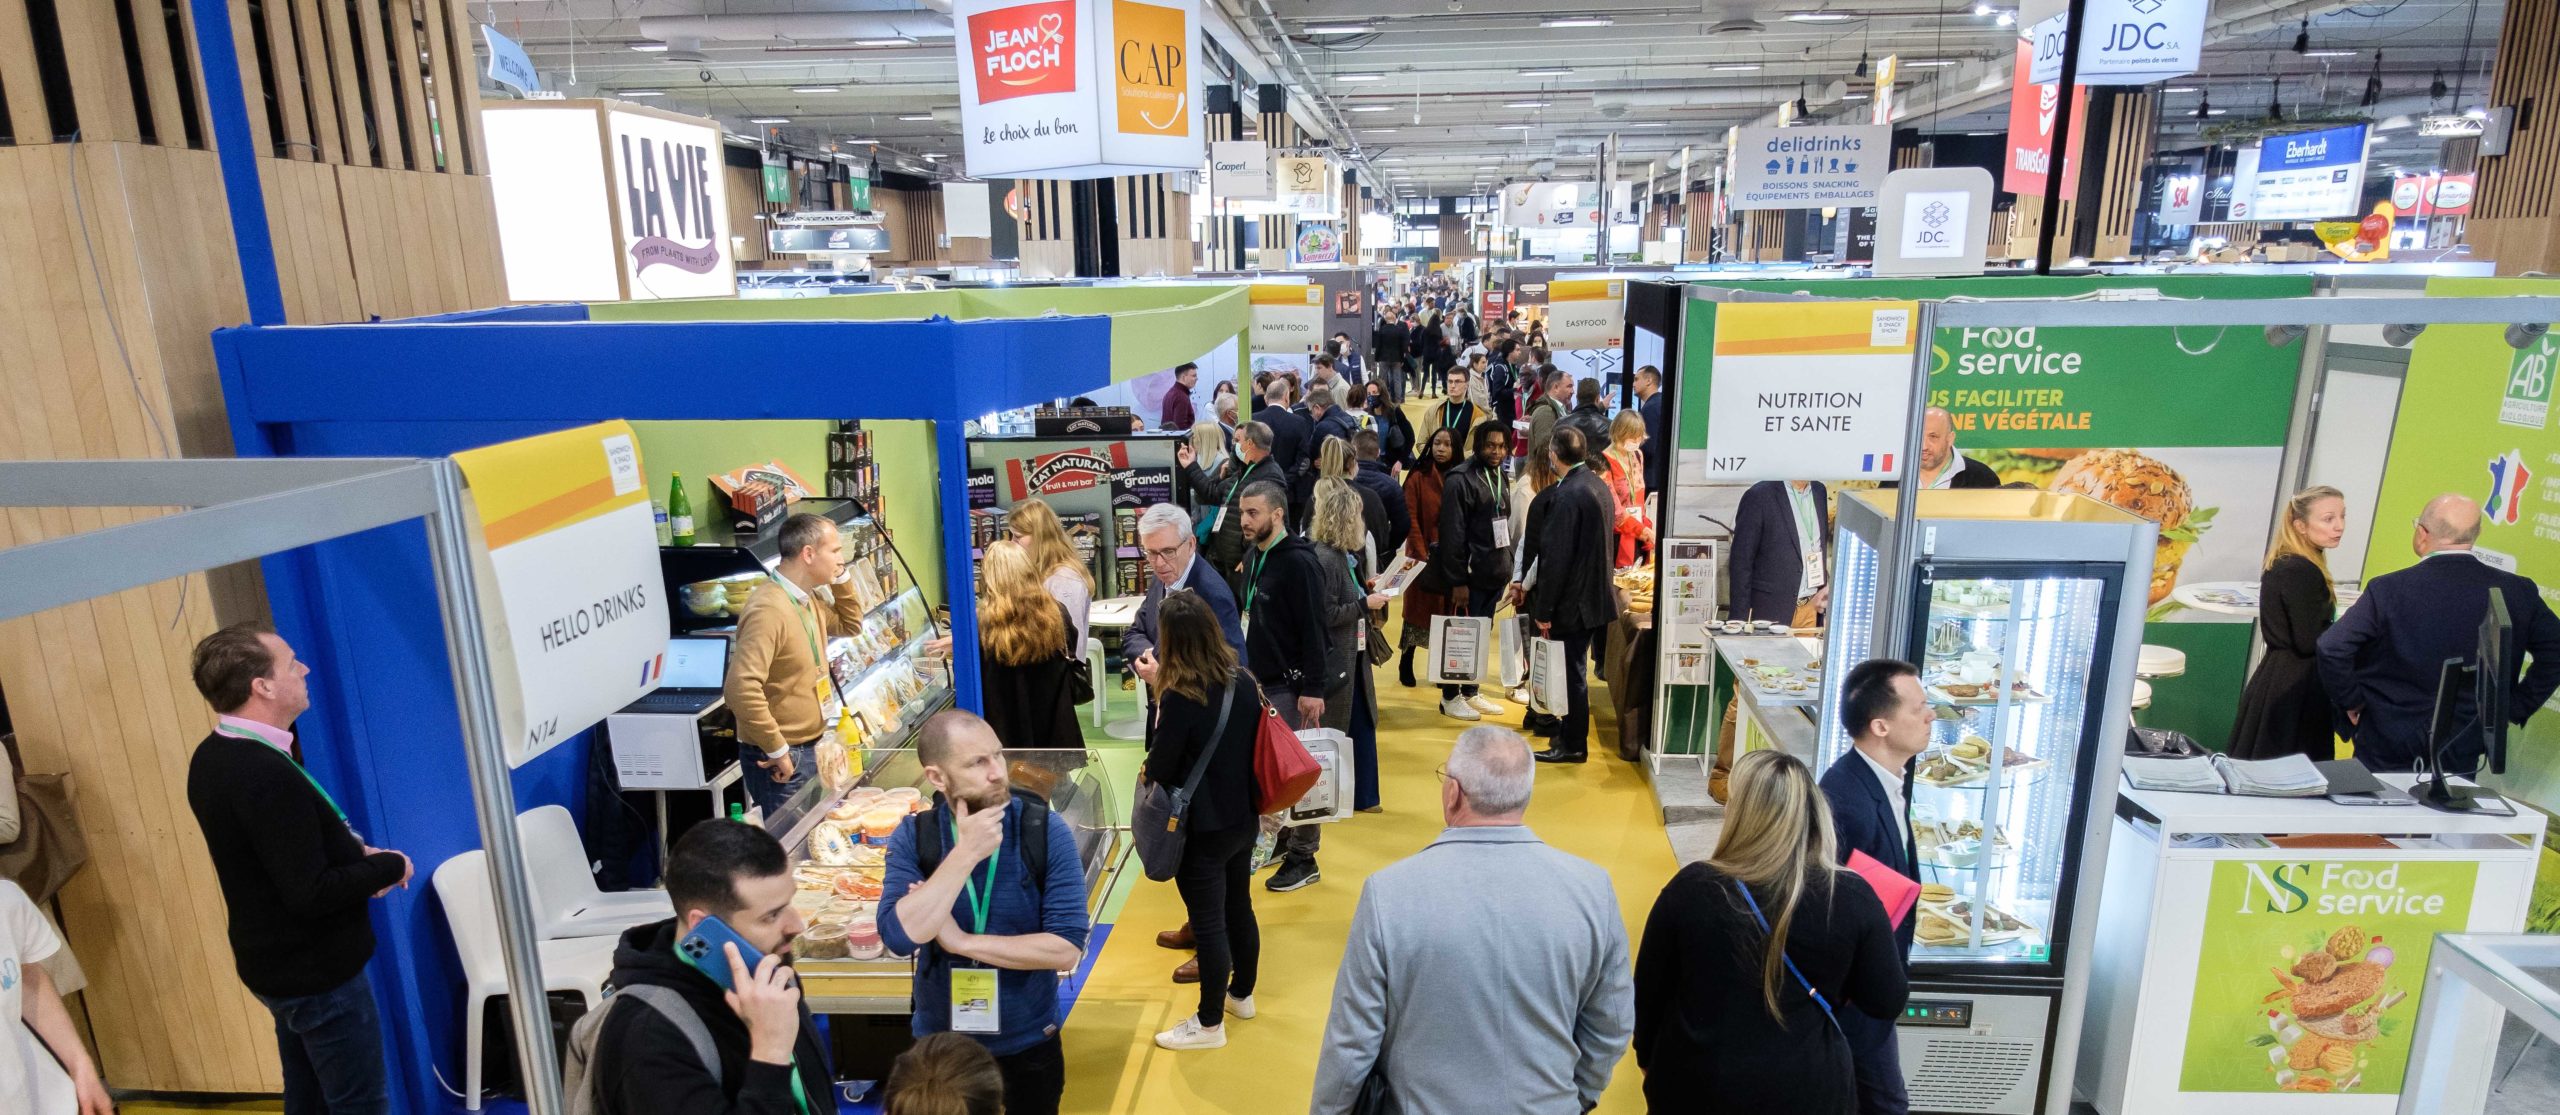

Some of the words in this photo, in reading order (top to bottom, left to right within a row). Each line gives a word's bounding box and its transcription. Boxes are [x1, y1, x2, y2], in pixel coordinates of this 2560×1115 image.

[984, 26, 1038, 53] JEAN
[2101, 22, 2167, 51] JDC
[500, 54, 528, 85] WELCOME
[1120, 39, 1181, 88] CAP
[2131, 57, 2151, 65] points
[983, 126, 995, 145] Le
[1000, 123, 1031, 142] choix
[1034, 119, 1050, 136] du
[1054, 117, 1078, 135] bon
[1766, 135, 1862, 153] delidrinks
[2285, 136, 2328, 159] Eberhardt
[1215, 161, 1246, 172] Cooperl
[2015, 147, 2069, 178] TRANSGOUT
[621, 134, 667, 238] LA
[663, 141, 715, 240] VIE
[1762, 181, 1809, 190] BOISSONS
[1812, 180, 1860, 189] SNACKING
[1814, 190, 1874, 199] EMBALLAGES
[1916, 231, 1944, 243] JDC
[642, 246, 659, 259] FROM
[660, 245, 684, 262] PLANTS
[685, 253, 700, 266] WITH
[700, 252, 713, 266] LOVE
[1262, 323, 1285, 332] NAIVE
[1287, 323, 1309, 332] FOOD
[1566, 318, 1607, 328] EASYFOOD
[1957, 344, 2082, 375] service
[2509, 353, 2548, 398] AB
[1757, 392, 1862, 410] NUTRITION
[1954, 389, 2063, 407] FACILITER
[1764, 416, 1785, 432] ET
[1790, 415, 1852, 432] SANTE
[1982, 408, 2092, 431] VÉGÉTALE
[1032, 467, 1051, 486] EAT
[1052, 457, 1106, 472] NATURAL
[1110, 468, 1136, 482] super
[1712, 456, 1746, 472] N17
[967, 474, 994, 487] anola
[1045, 481, 1061, 490] fruit
[1067, 480, 1079, 488] nut
[1080, 478, 1093, 486] bar
[1124, 472, 1170, 488] granola
[593, 583, 646, 629] DRINKS
[541, 608, 589, 652] HELLO
[528, 712, 559, 750] N14
[2321, 862, 2399, 890] Food
[2316, 887, 2444, 916] service
